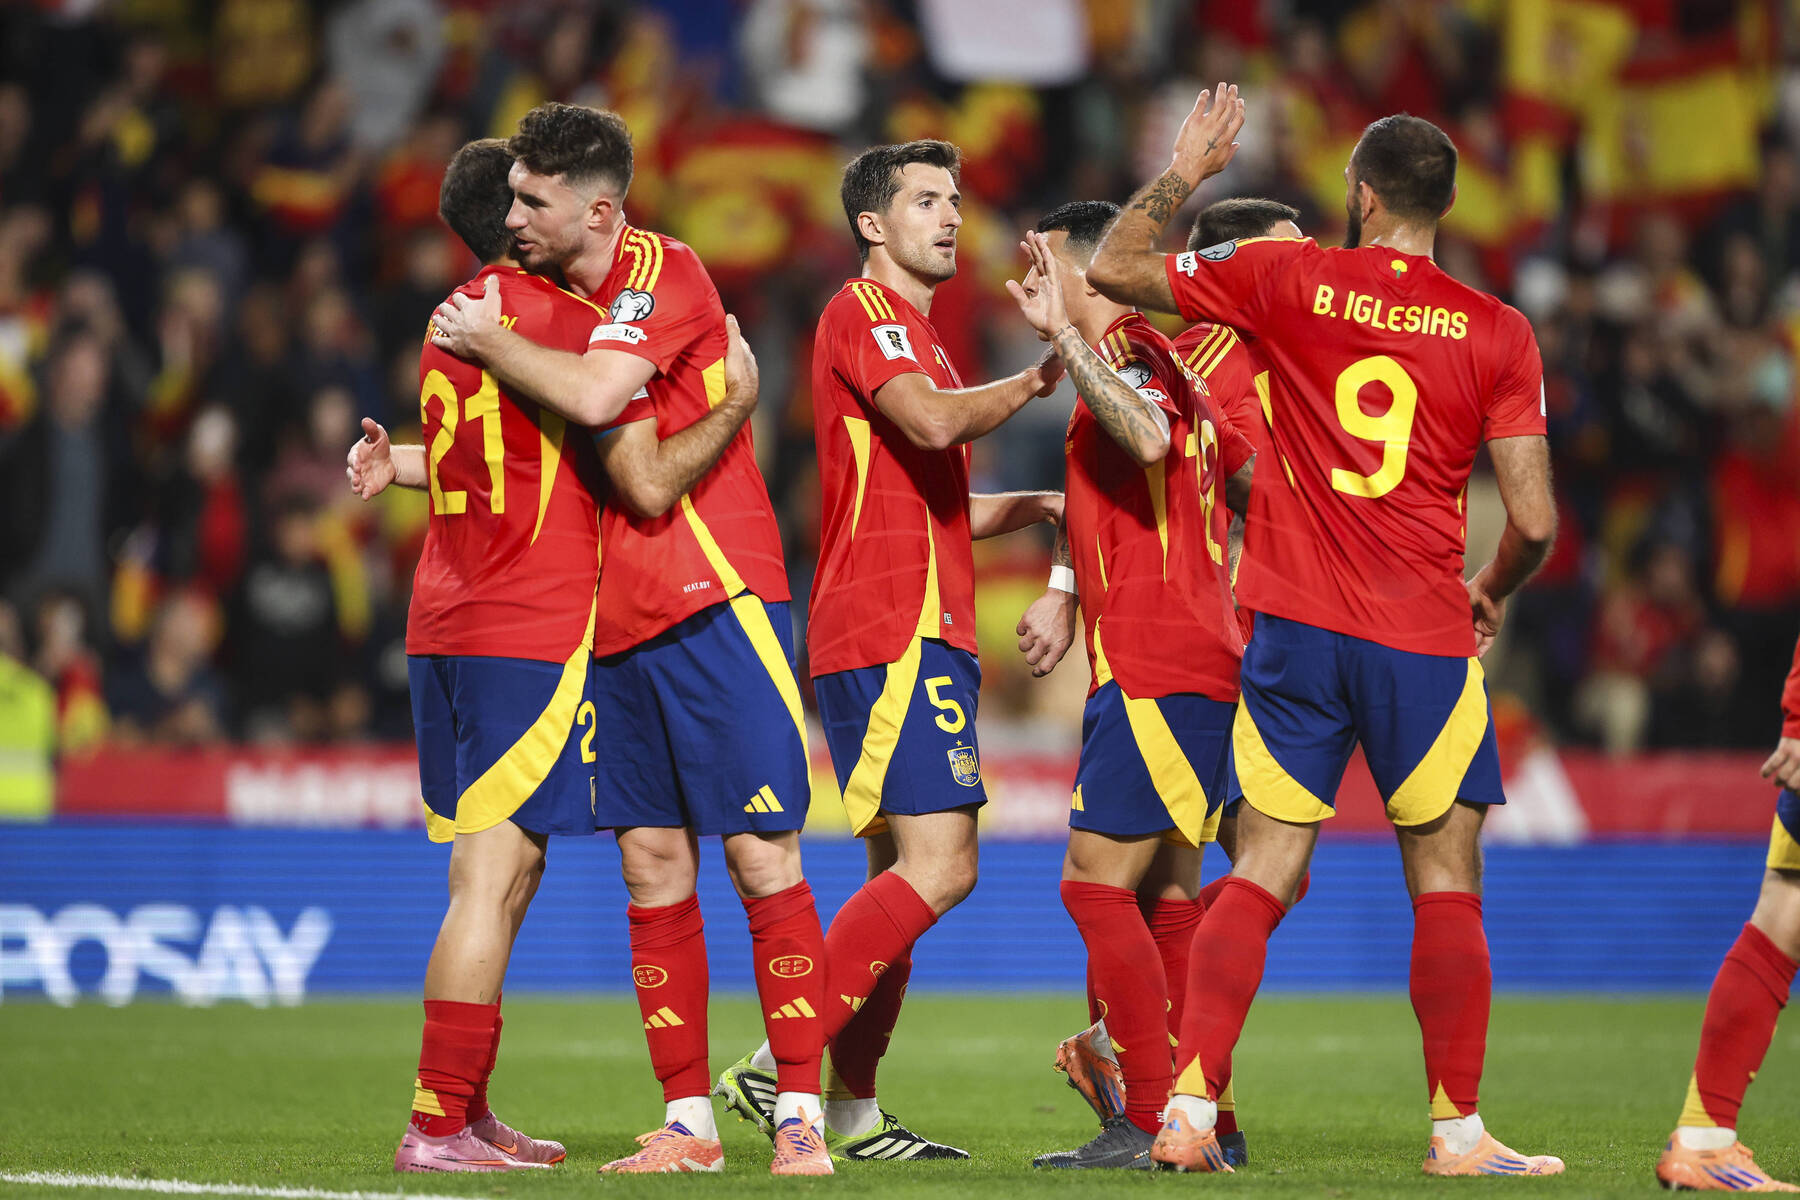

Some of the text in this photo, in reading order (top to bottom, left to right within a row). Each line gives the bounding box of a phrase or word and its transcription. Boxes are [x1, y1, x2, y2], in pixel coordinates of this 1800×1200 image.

[624, 328, 639, 339] 10
[1313, 284, 1469, 340] B. IGLESIAS
[420, 368, 505, 515] 21
[1331, 355, 1418, 499] 9
[1185, 411, 1223, 566] 12
[924, 675, 966, 734] 5
